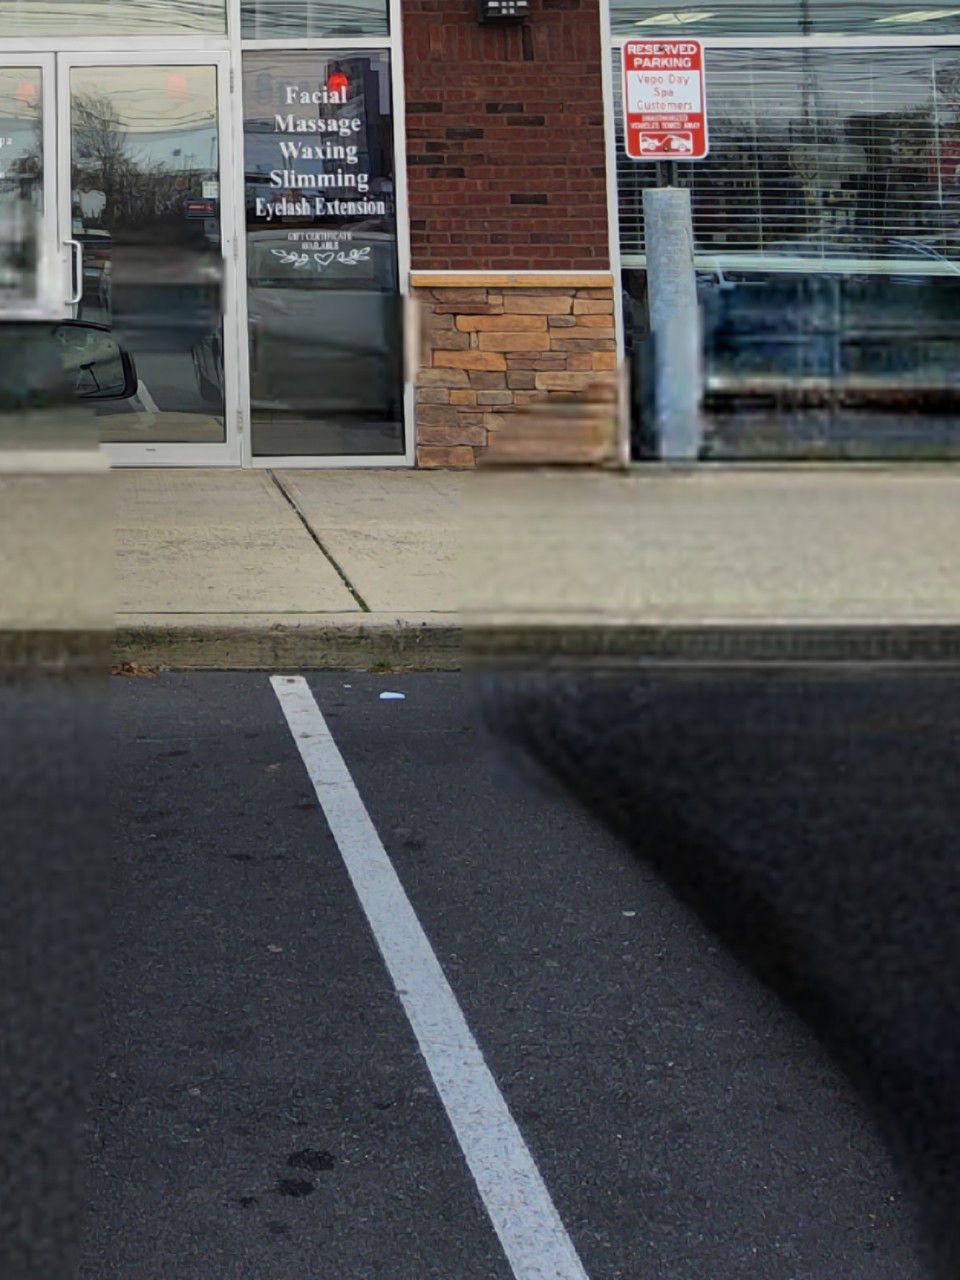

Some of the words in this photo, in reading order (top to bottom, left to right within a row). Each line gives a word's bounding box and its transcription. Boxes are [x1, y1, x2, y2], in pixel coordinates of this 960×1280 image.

[626, 43, 697, 55] RESERVED
[633, 57, 692, 68] PARKING
[668, 73, 690, 86] Day
[285, 85, 348, 105] Facial
[653, 87, 675, 98] Spa
[637, 100, 693, 111] Customers
[273, 113, 362, 136] Massage
[279, 141, 359, 164] Waxing
[269, 168, 370, 193] Slimming
[255, 196, 311, 221] Eyelash
[315, 196, 386, 216] Extension
